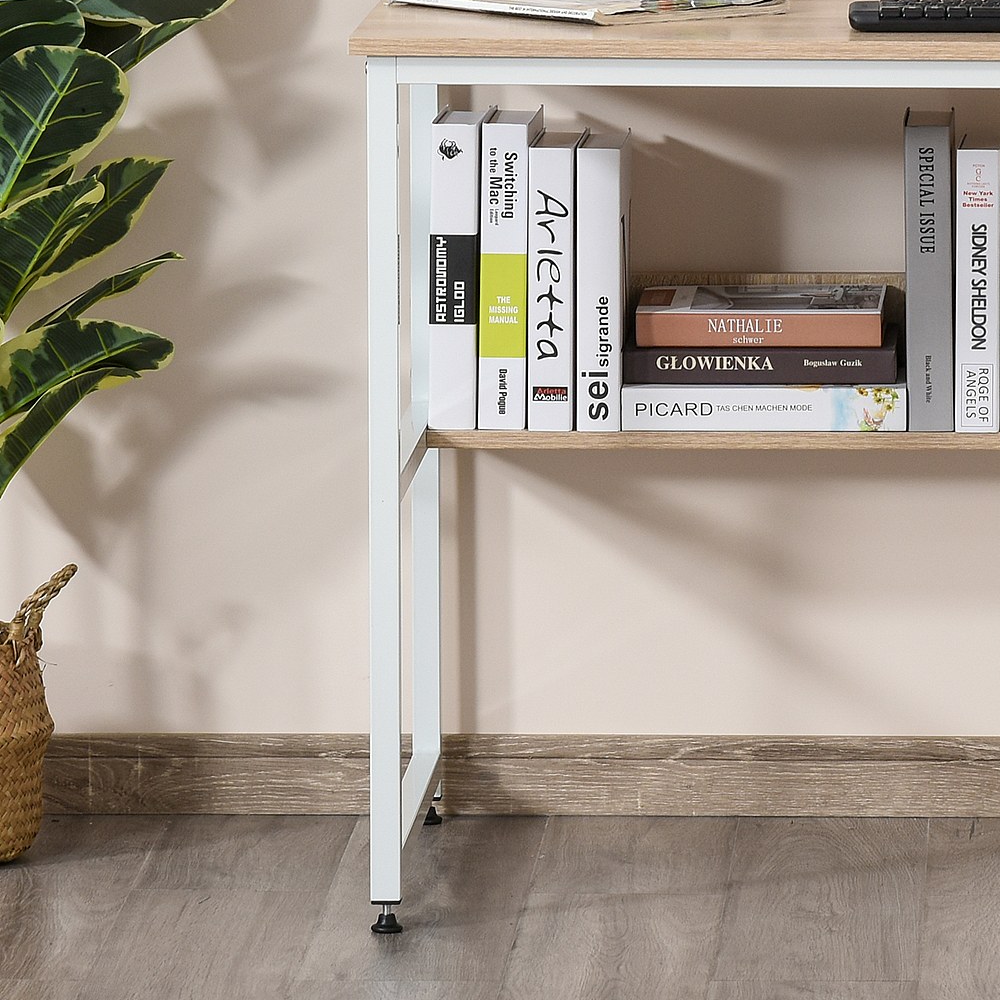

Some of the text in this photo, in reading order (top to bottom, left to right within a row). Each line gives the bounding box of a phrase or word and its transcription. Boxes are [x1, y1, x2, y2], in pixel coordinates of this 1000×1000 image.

[489, 147, 503, 205] to the Mac
[500, 152, 518, 219] Switching
[918, 147, 936, 254] SPECIAL ISSUE
[435, 236, 447, 323] ASTRONOMY
[970, 224, 988, 351] SIDNEY SHELDON
[453, 281, 465, 323] IGLOO
[496, 296, 511, 304] THE
[488, 306, 519, 314] MISSING
[488, 316, 519, 324] MANUAL
[707, 318, 783, 333] NATHALIE
[655, 355, 774, 371] GŁOWIENKA
[839, 358, 863, 367] Guzik
[924, 355, 933, 372] Black
[497, 368, 508, 415] David Pogue
[581, 371, 609, 421] sei
[925, 385, 933, 404] White
[965, 370, 977, 419] ANGELS
[634, 402, 813, 418] PICARD TAS CHEN MACHEN MODE
[978, 406, 990, 423] OF
